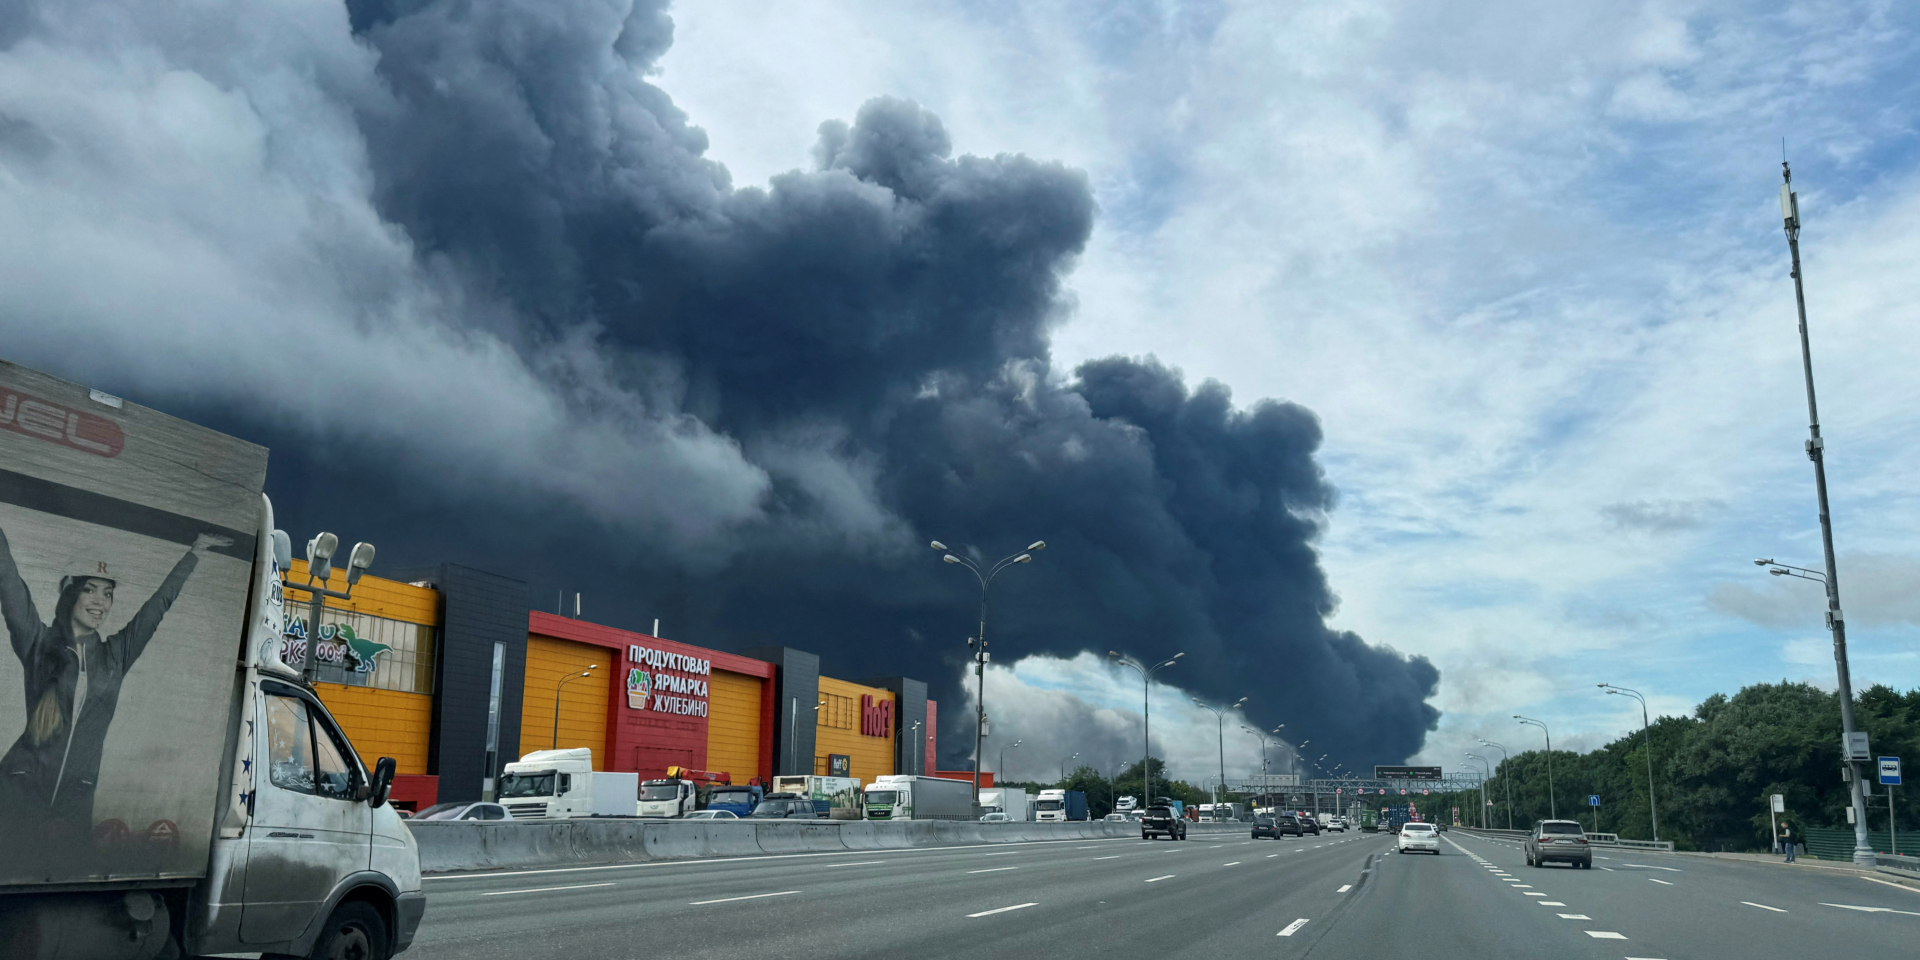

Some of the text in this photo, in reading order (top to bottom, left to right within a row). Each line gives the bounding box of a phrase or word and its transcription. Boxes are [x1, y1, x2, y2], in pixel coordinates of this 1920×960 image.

[97, 561, 108, 574] R
[628, 644, 710, 676] ПРОДУКТОВАЯ
[654, 673, 708, 697] ЯРМАРКА
[653, 694, 708, 718] ЖУЛЕБИНО
